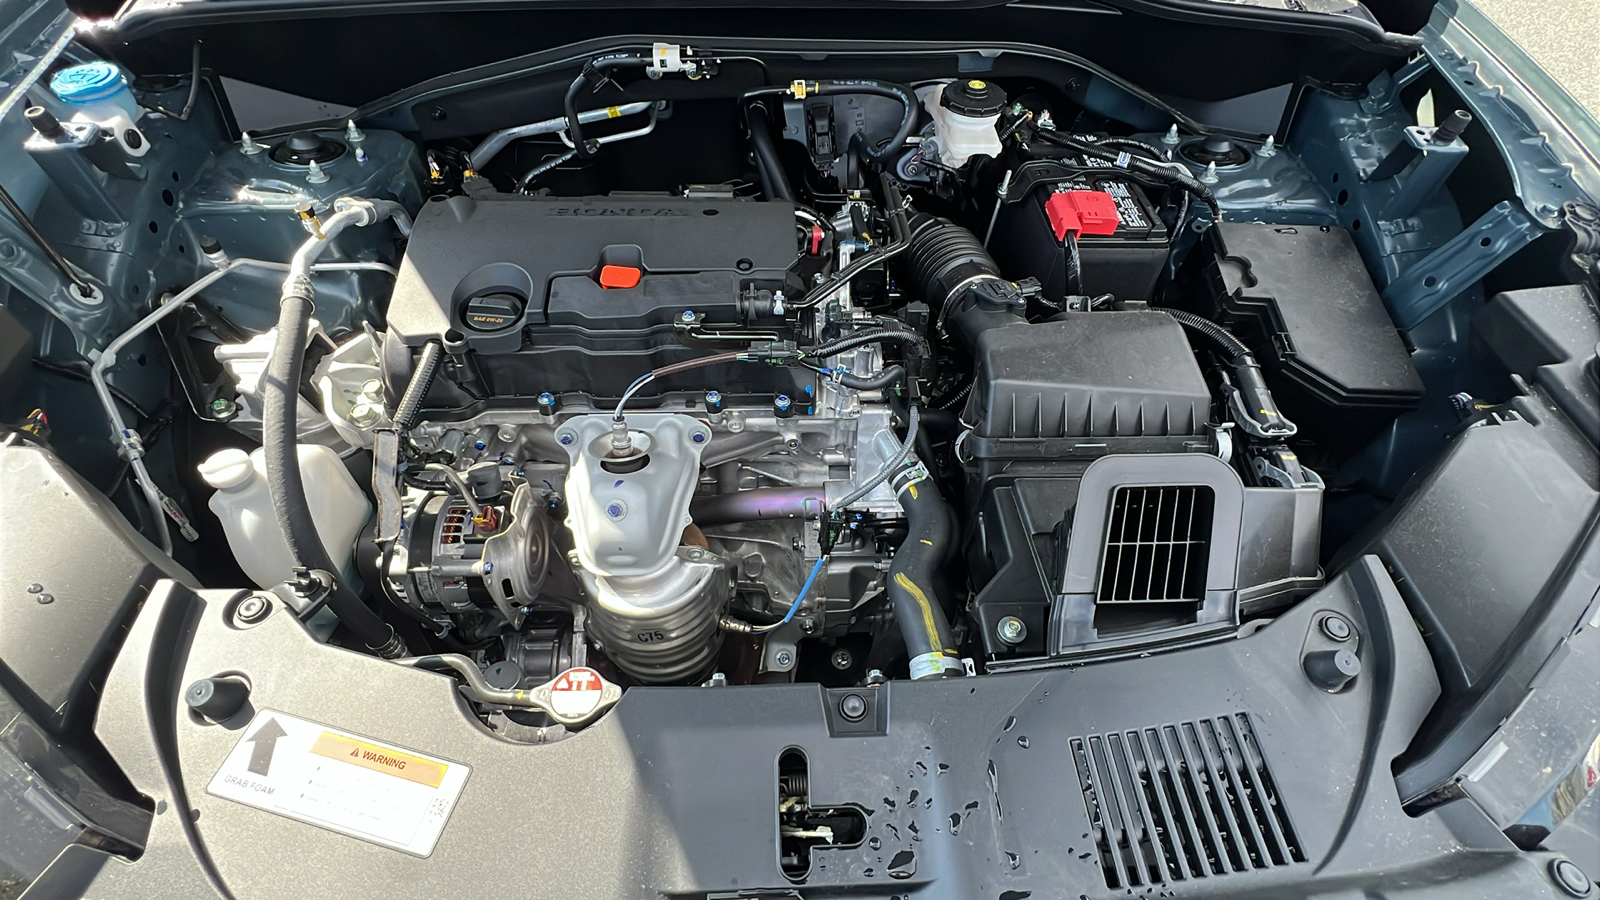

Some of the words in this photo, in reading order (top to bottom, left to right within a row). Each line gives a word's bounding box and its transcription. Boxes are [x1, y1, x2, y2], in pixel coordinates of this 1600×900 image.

[637, 630, 664, 643] C75
[362, 750, 407, 770] WARNING
[224, 774, 250, 788] GRAB
[249, 781, 275, 796] FOAM
